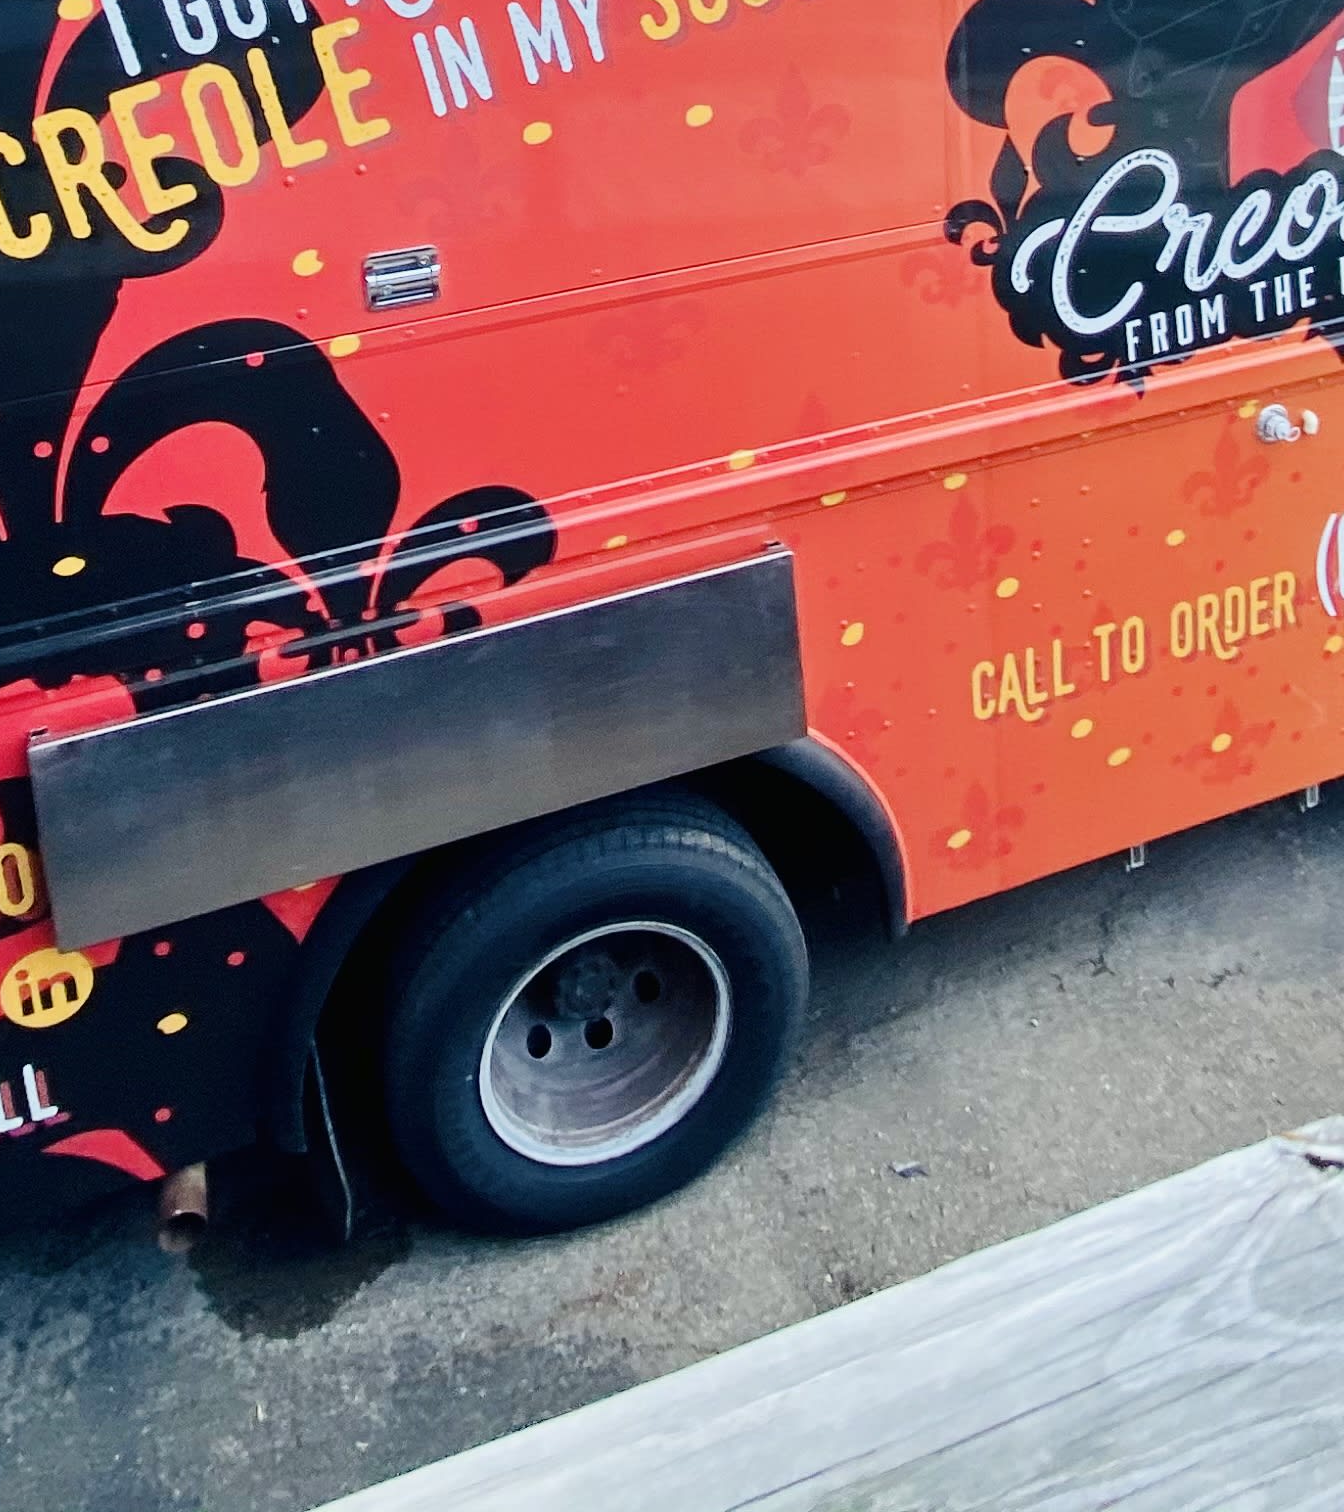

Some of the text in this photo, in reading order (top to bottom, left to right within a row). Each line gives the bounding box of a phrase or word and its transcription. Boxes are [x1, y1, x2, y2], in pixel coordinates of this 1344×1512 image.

[412, 16, 494, 118] IN
[1123, 298, 1228, 364] FROM
[1248, 264, 1317, 325] THE
[970, 638, 1076, 723] CALL
[1091, 614, 1146, 682] TO
[1168, 569, 1298, 662] ORDER
